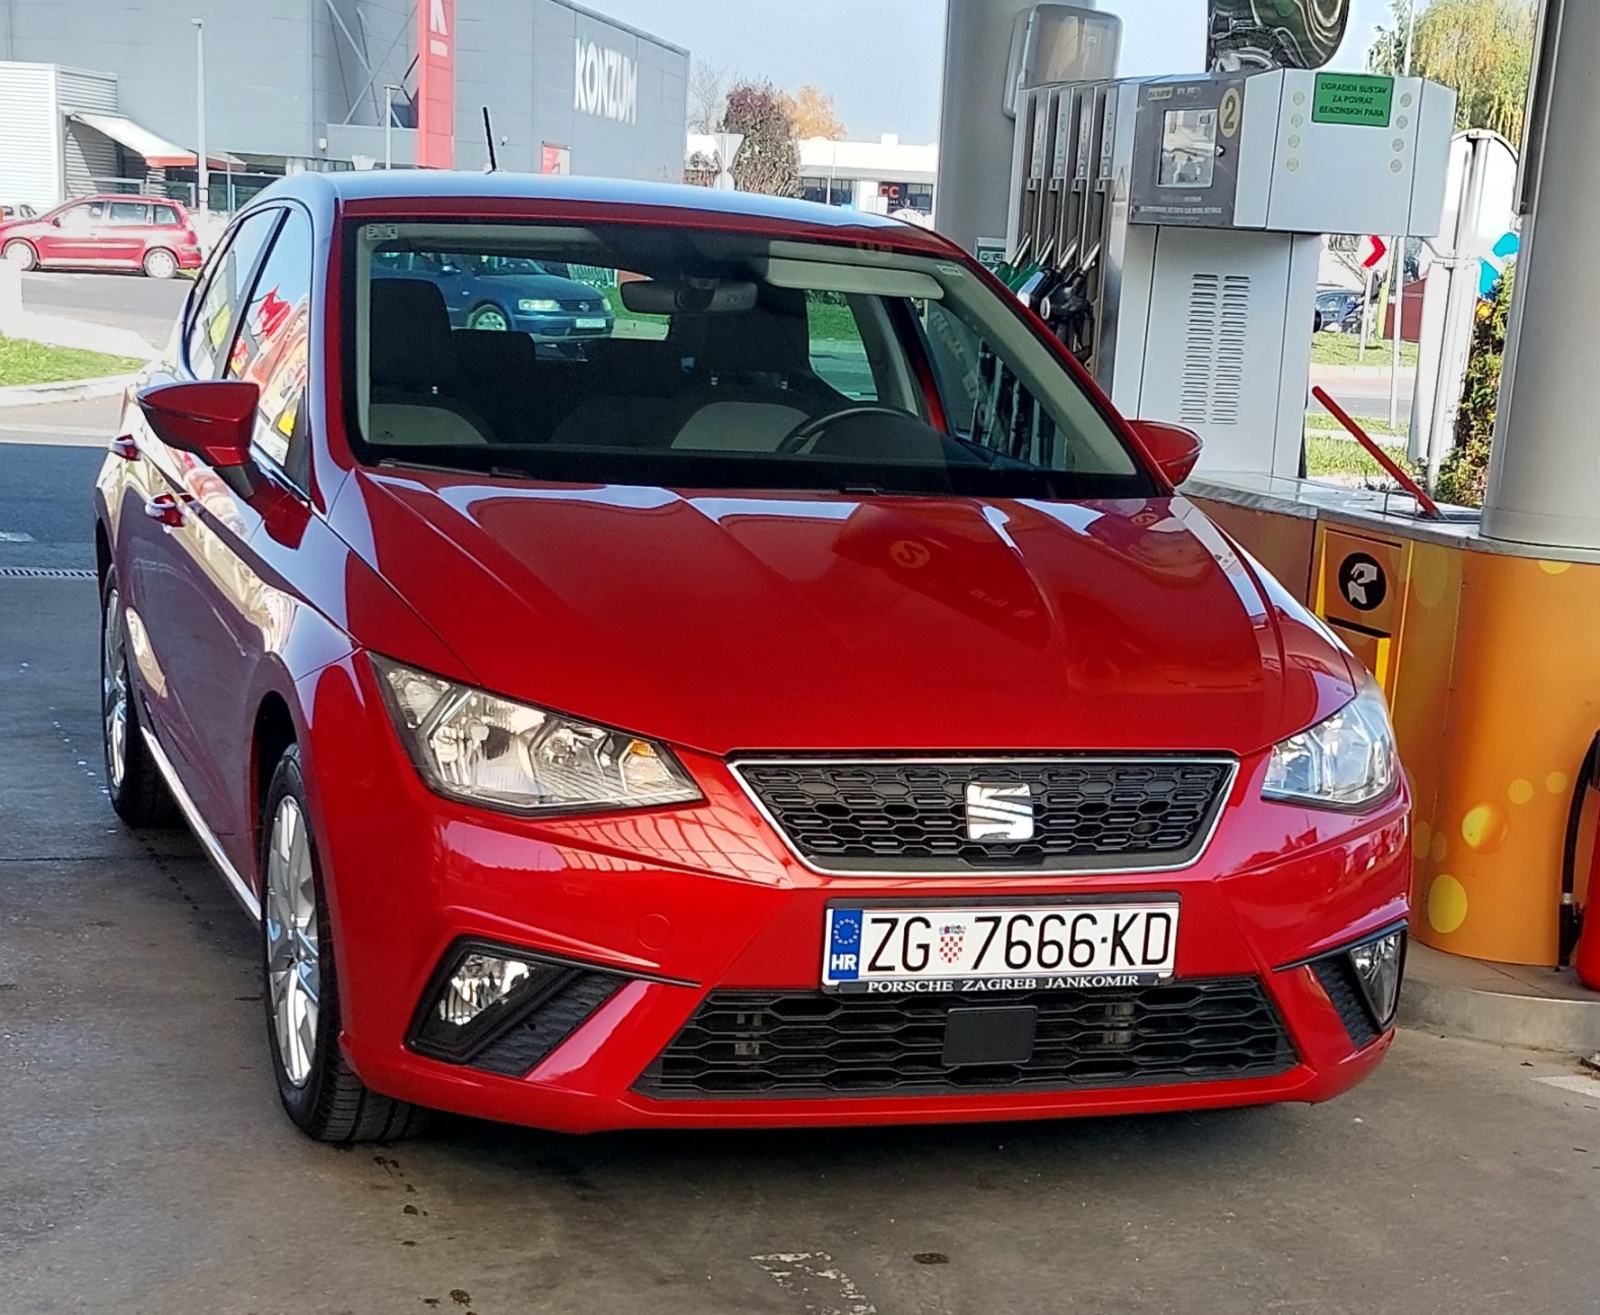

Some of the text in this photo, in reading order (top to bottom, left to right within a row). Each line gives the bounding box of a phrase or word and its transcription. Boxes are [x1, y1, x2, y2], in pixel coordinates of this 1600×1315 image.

[574, 37, 638, 125] KONZUM
[1359, 85, 1388, 94] SUSTAV
[1332, 94, 1374, 104] ZA POVRAT
[1223, 95, 1236, 129] 2
[1364, 108, 1384, 117] PARA
[868, 916, 932, 972] ZG
[831, 954, 857, 971] HR
[868, 975, 1139, 993] PORSCHE ZAGREB JANKOMIR
